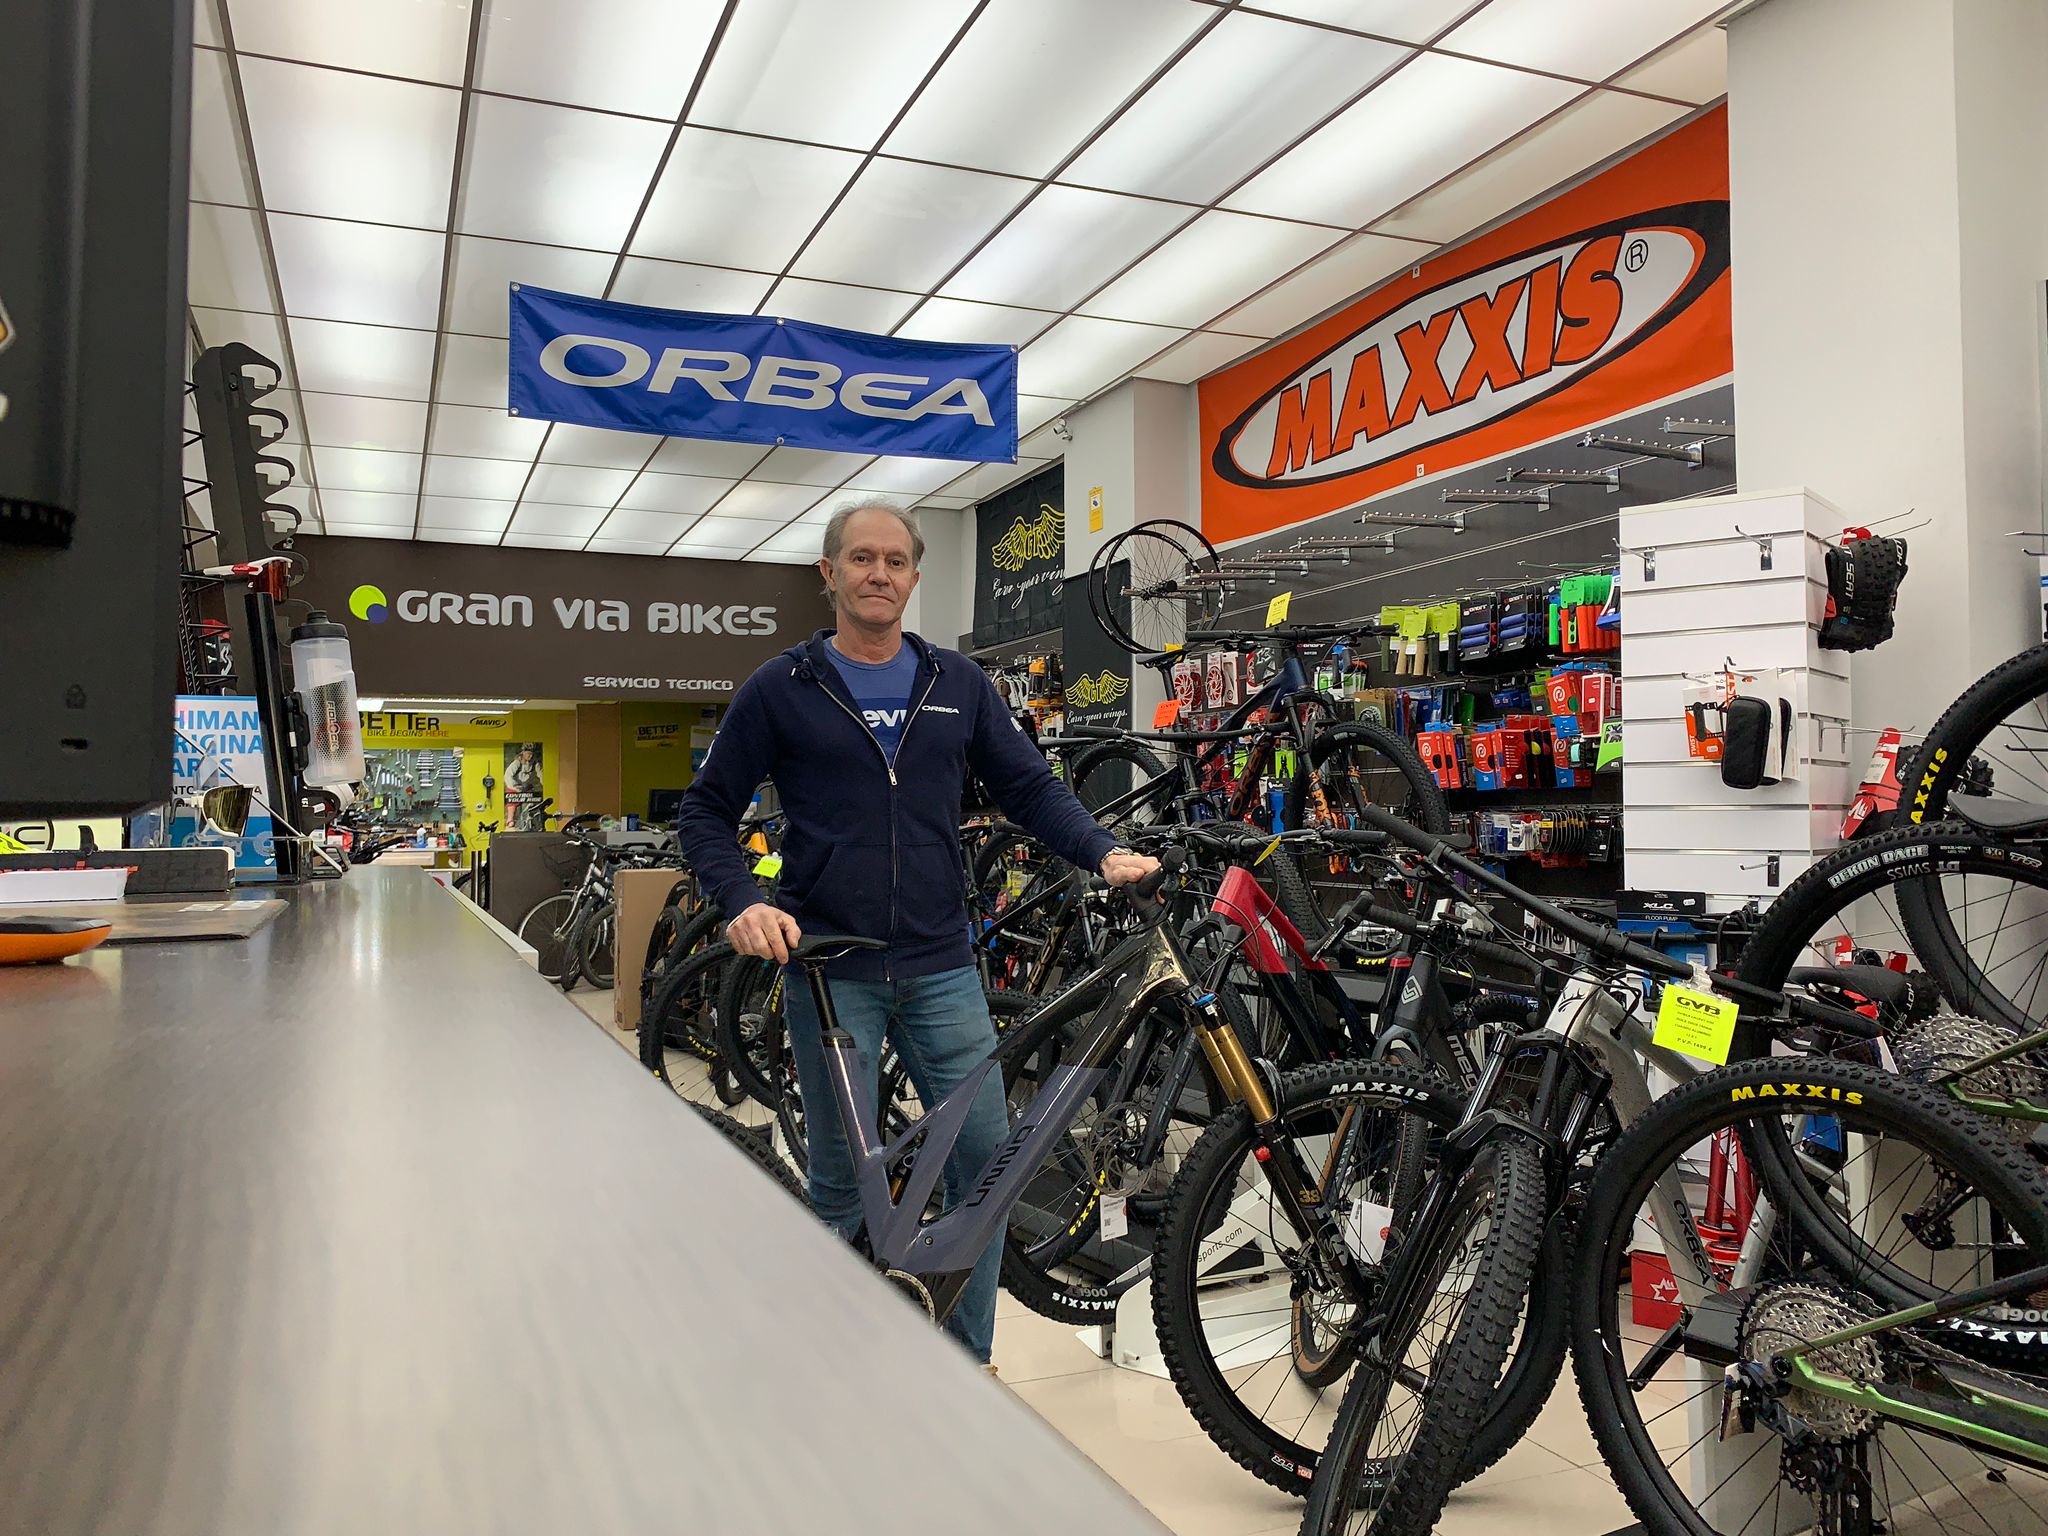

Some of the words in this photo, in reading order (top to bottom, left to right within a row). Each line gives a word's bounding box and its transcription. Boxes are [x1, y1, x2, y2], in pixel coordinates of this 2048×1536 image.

[1266, 231, 1624, 480] MAXXIS
[539, 335, 996, 427] ORBEA
[1845, 561, 1855, 600] SEAT
[648, 602, 778, 637] BIKES
[583, 676, 660, 689] SERVICIO
[665, 679, 734, 691] TECNICO
[921, 705, 960, 715] ORBEA
[1066, 709, 1083, 725] Earn
[1083, 711, 1102, 726] your
[326, 700, 340, 752] FIDLOCK
[367, 729, 388, 737] BIKE
[389, 729, 424, 737] BEGINS
[425, 730, 449, 738] HERE
[638, 724, 679, 735] BETTER
[1689, 735, 1697, 755] TWIST
[1828, 854, 1881, 889] REKON
[1881, 844, 1929, 865] RACE
[1886, 862, 1930, 881] SWISS
[1936, 860, 1961, 872] DT
[1676, 996, 1721, 1016] GVB
[1329, 1081, 1430, 1101] MAXXIS
[1731, 1083, 1864, 1105] MAXXIS
[1673, 1199, 1711, 1286] ORBEA
[1051, 1292, 1117, 1311] MAXXIS
